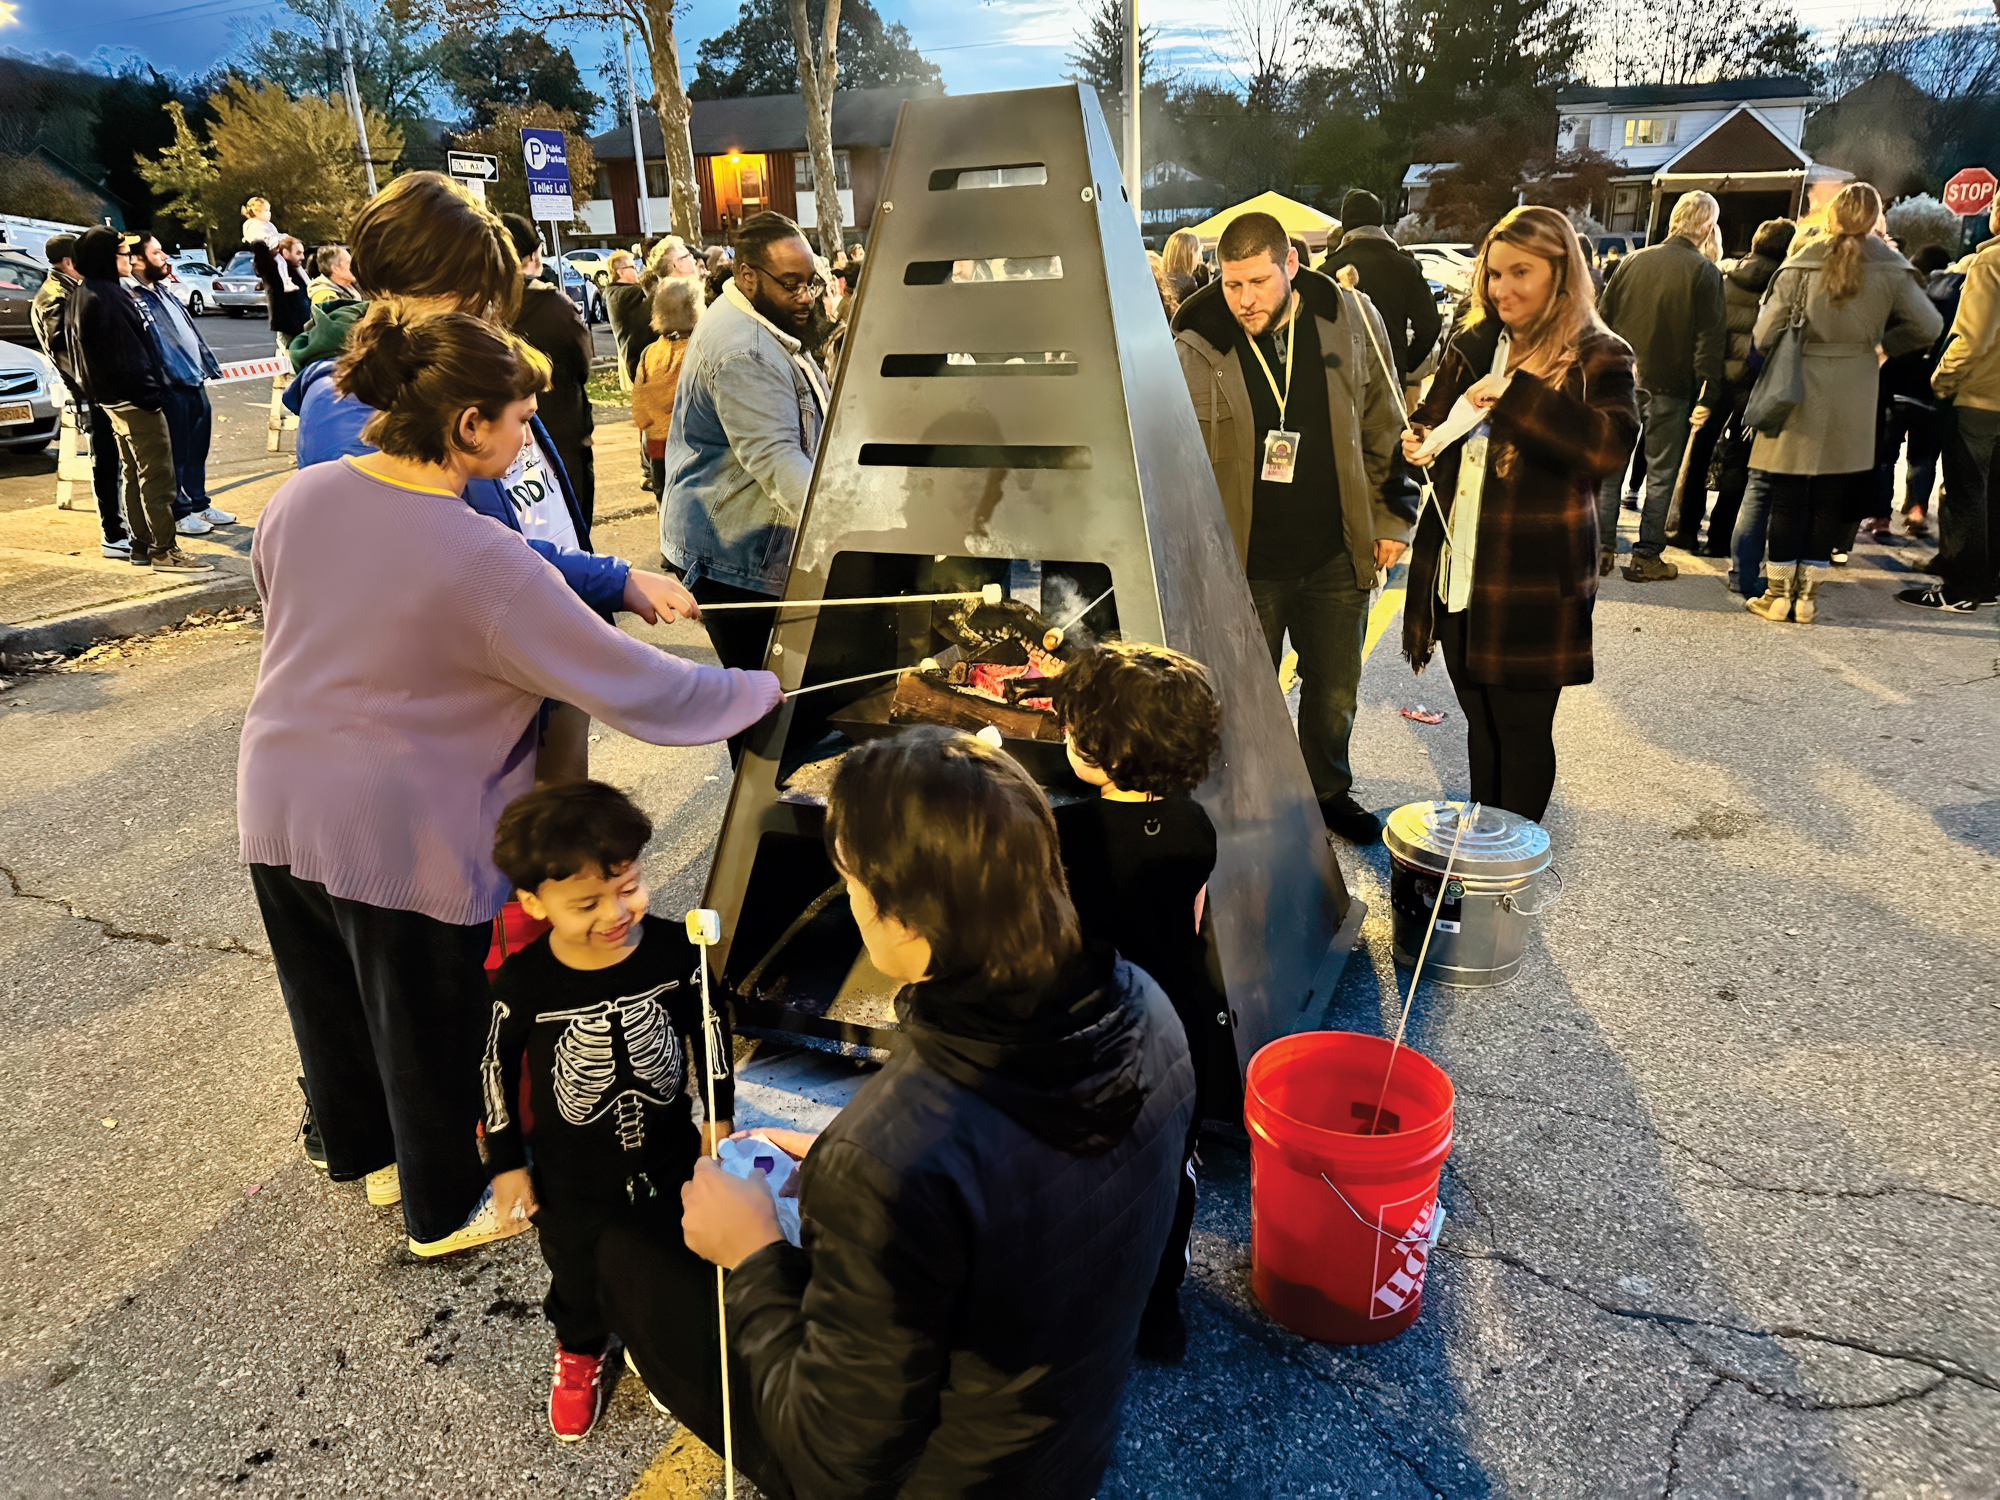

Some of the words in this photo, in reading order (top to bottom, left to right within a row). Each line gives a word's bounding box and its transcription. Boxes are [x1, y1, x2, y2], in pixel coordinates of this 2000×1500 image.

[546, 143, 562, 153] Public
[546, 154, 567, 166] Parking
[554, 182, 568, 194] Lot
[1947, 182, 1993, 202] STOP
[1390, 1200, 1433, 1256] THE
